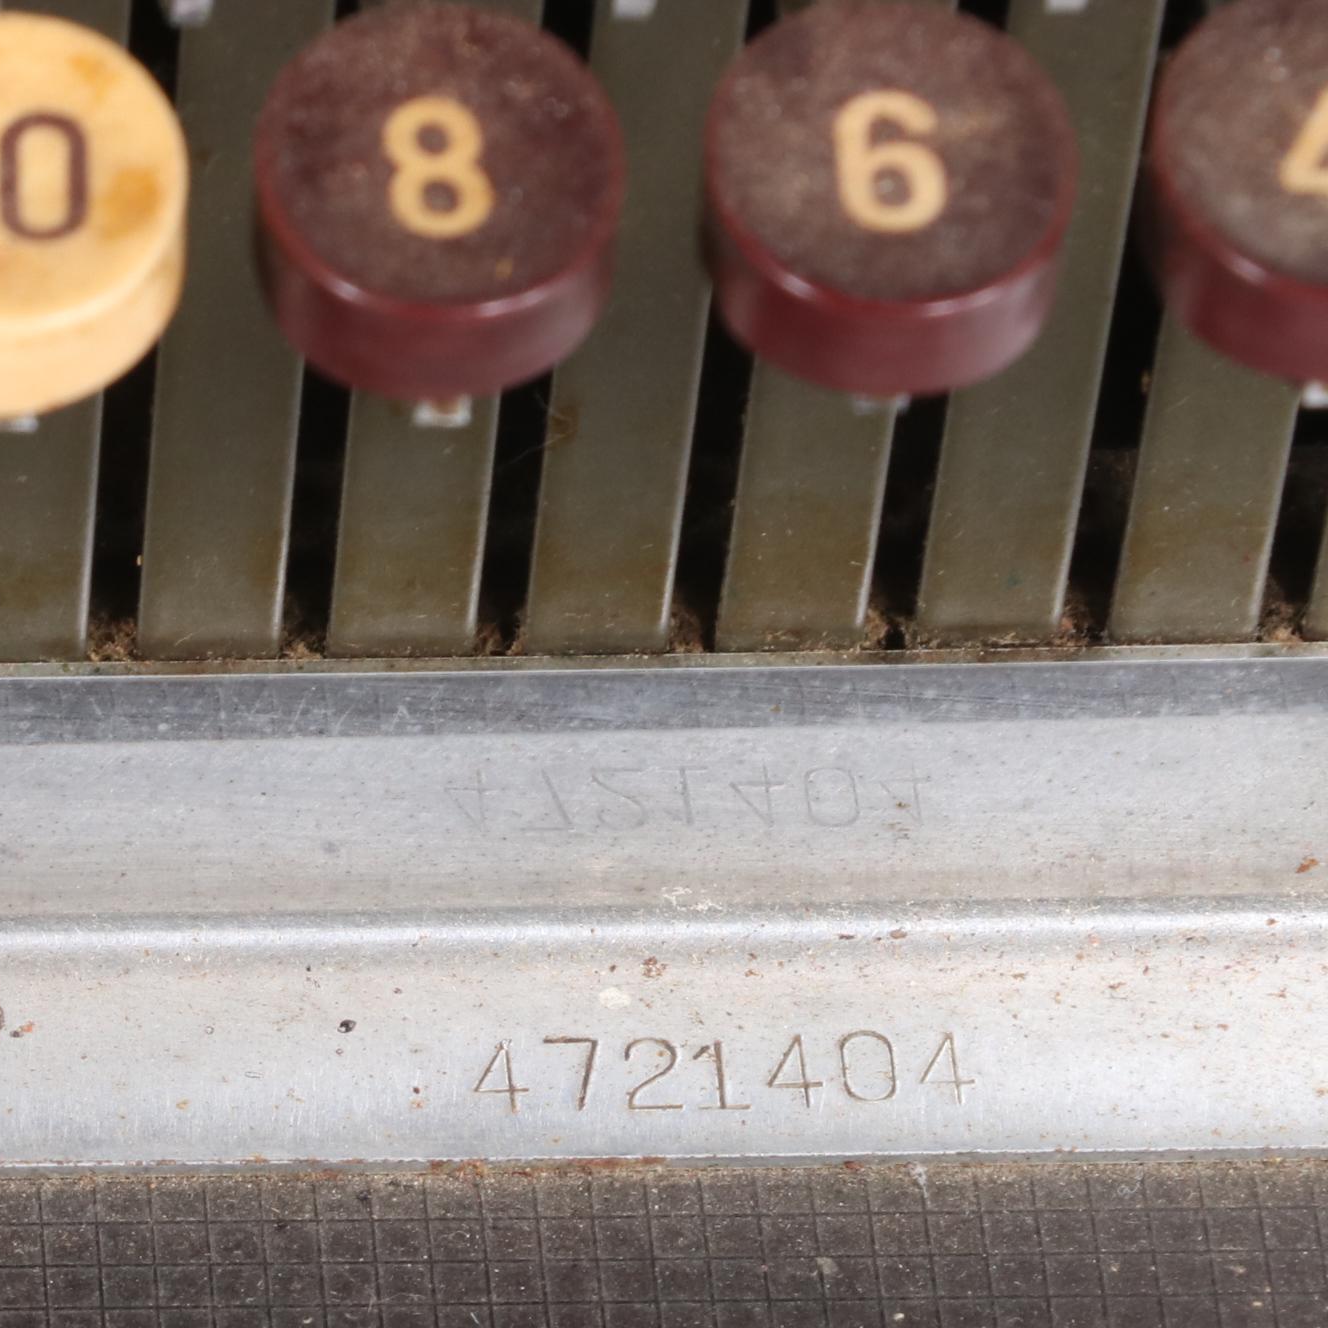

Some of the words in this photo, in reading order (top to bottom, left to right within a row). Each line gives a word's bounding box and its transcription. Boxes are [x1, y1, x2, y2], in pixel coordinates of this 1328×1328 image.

[382, 94, 496, 240] 8
[831, 88, 948, 235] 6
[473, 1029, 977, 1112] 4721404
